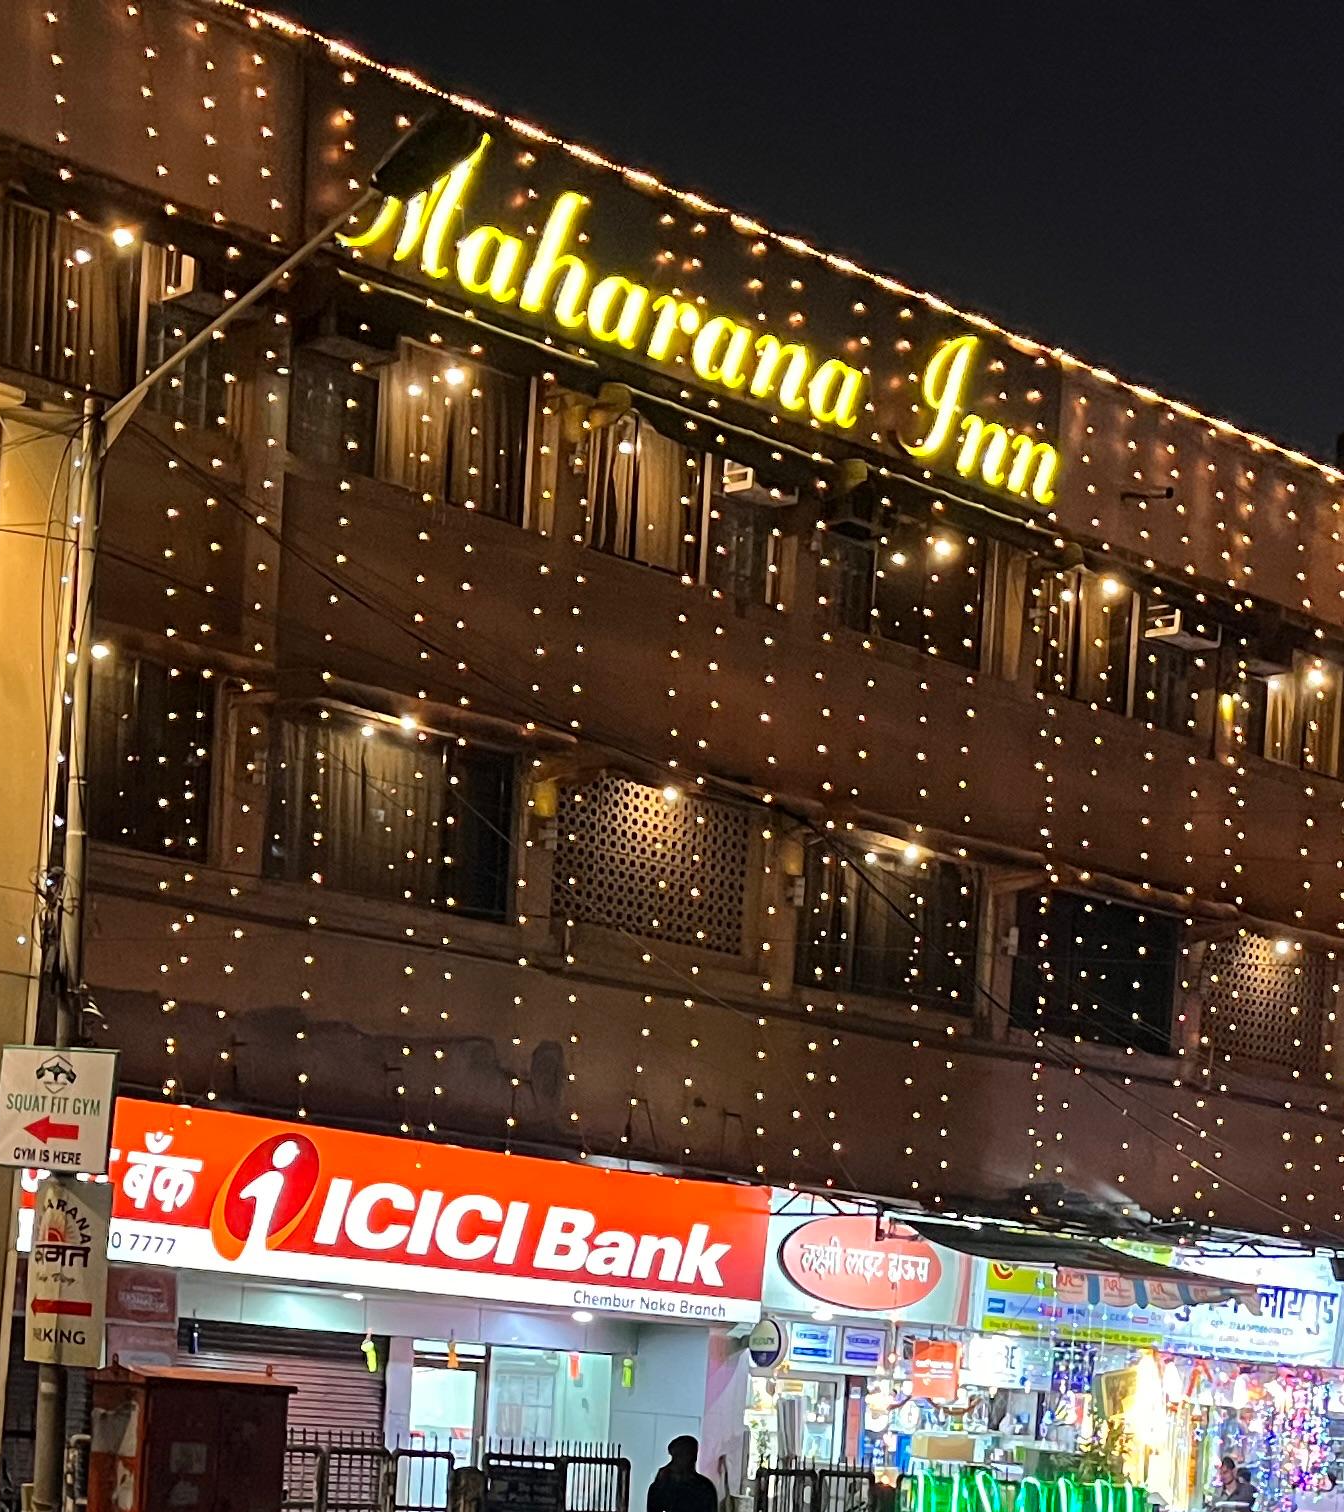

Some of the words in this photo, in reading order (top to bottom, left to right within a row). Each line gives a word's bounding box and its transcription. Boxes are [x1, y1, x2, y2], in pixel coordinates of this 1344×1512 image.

[337, 133, 866, 428] Maharana
[896, 334, 1060, 505] Inn
[5, 1092, 49, 1114] SQUAT
[51, 1096, 69, 1114] FIT
[72, 1097, 102, 1116] GYM
[13, 1147, 37, 1163] GYM
[39, 1149, 51, 1164] IS
[53, 1150, 82, 1166] HERE
[130, 1233, 177, 1255] 7777
[313, 1177, 533, 1267] ICICI
[535, 1203, 732, 1288] Bank
[572, 1290, 635, 1311] Chembur
[639, 1298, 676, 1315] Naka
[682, 1300, 727, 1318] Branch
